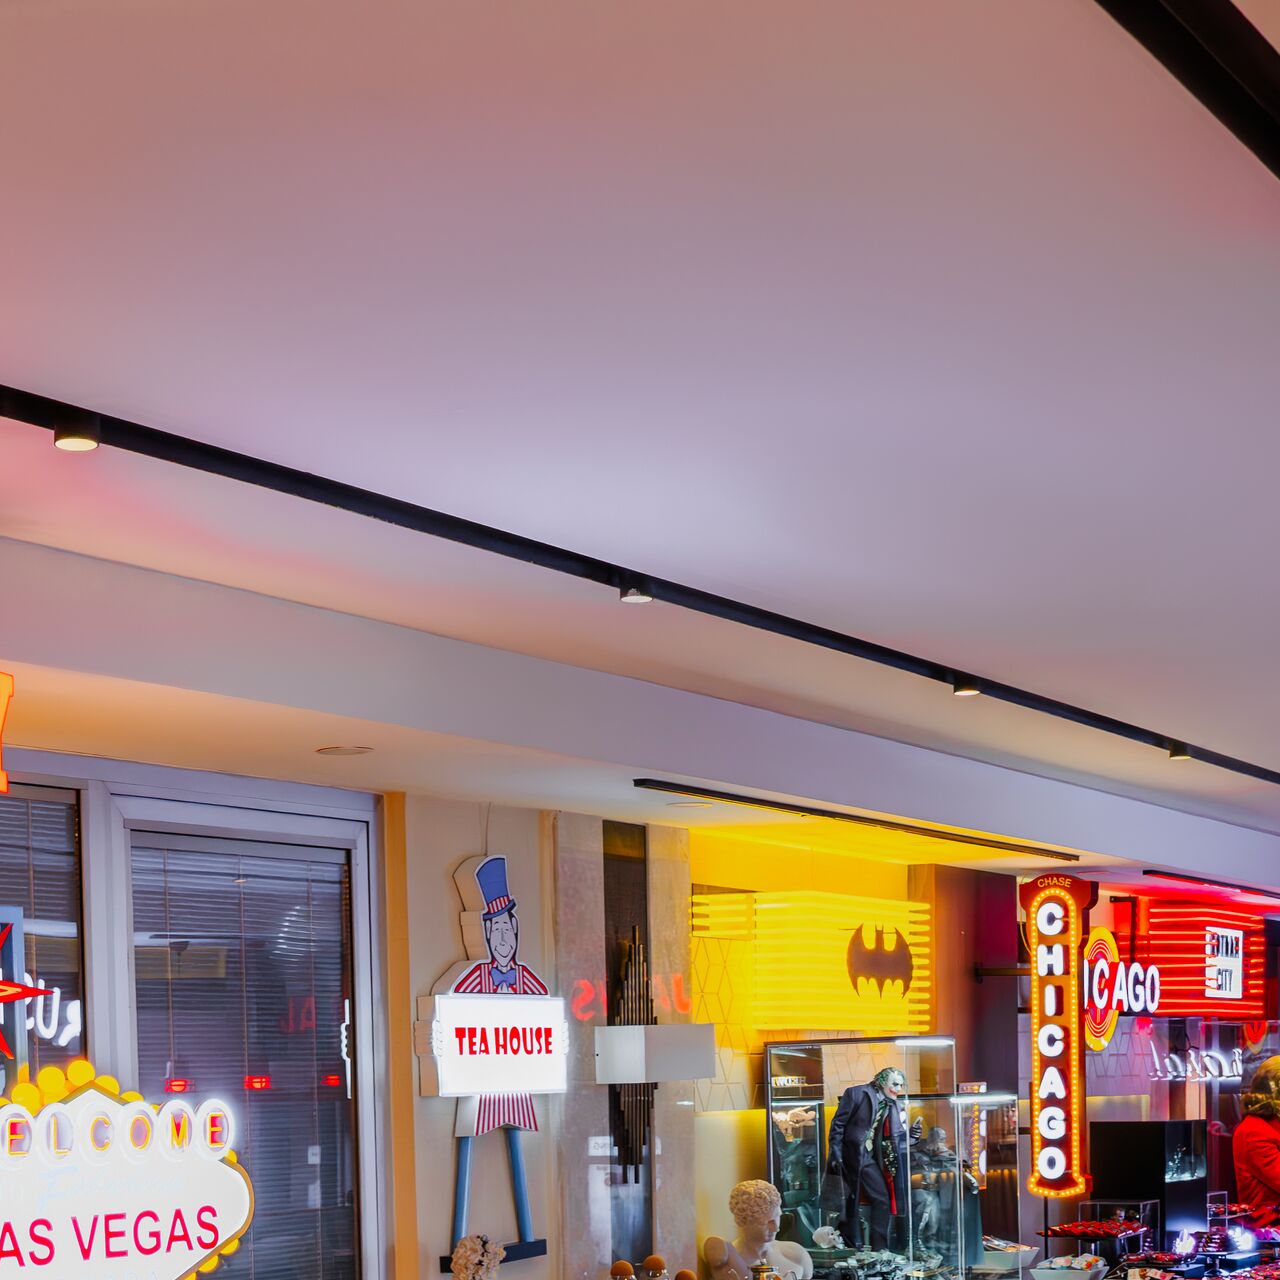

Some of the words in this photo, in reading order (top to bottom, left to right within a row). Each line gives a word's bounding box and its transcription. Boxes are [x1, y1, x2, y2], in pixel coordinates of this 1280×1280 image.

[1037, 877, 1072, 888] CHASE
[455, 1029, 490, 1056] TEA
[495, 1026, 553, 1056] HOUSE
[1036, 902, 1067, 1180] CHICAGO
[71, 1205, 220, 1261] VEGAS
